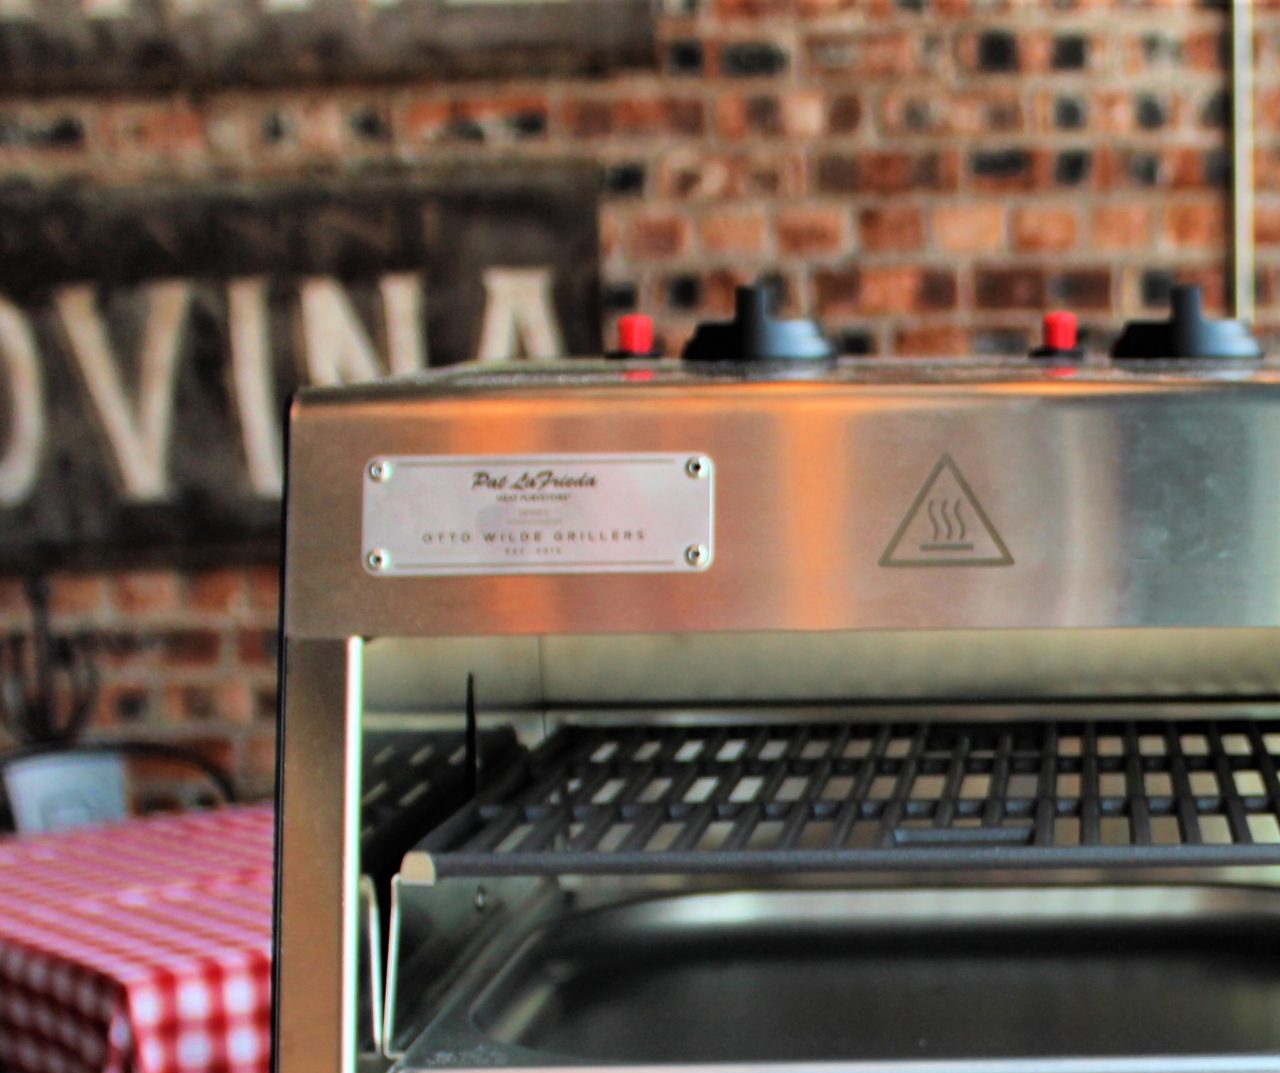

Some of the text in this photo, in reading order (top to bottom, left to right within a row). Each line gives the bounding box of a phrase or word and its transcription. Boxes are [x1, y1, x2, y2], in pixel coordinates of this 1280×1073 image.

[472, 471, 507, 490] Pat
[422, 530, 645, 544] OTTO WILDE GRILLERS
